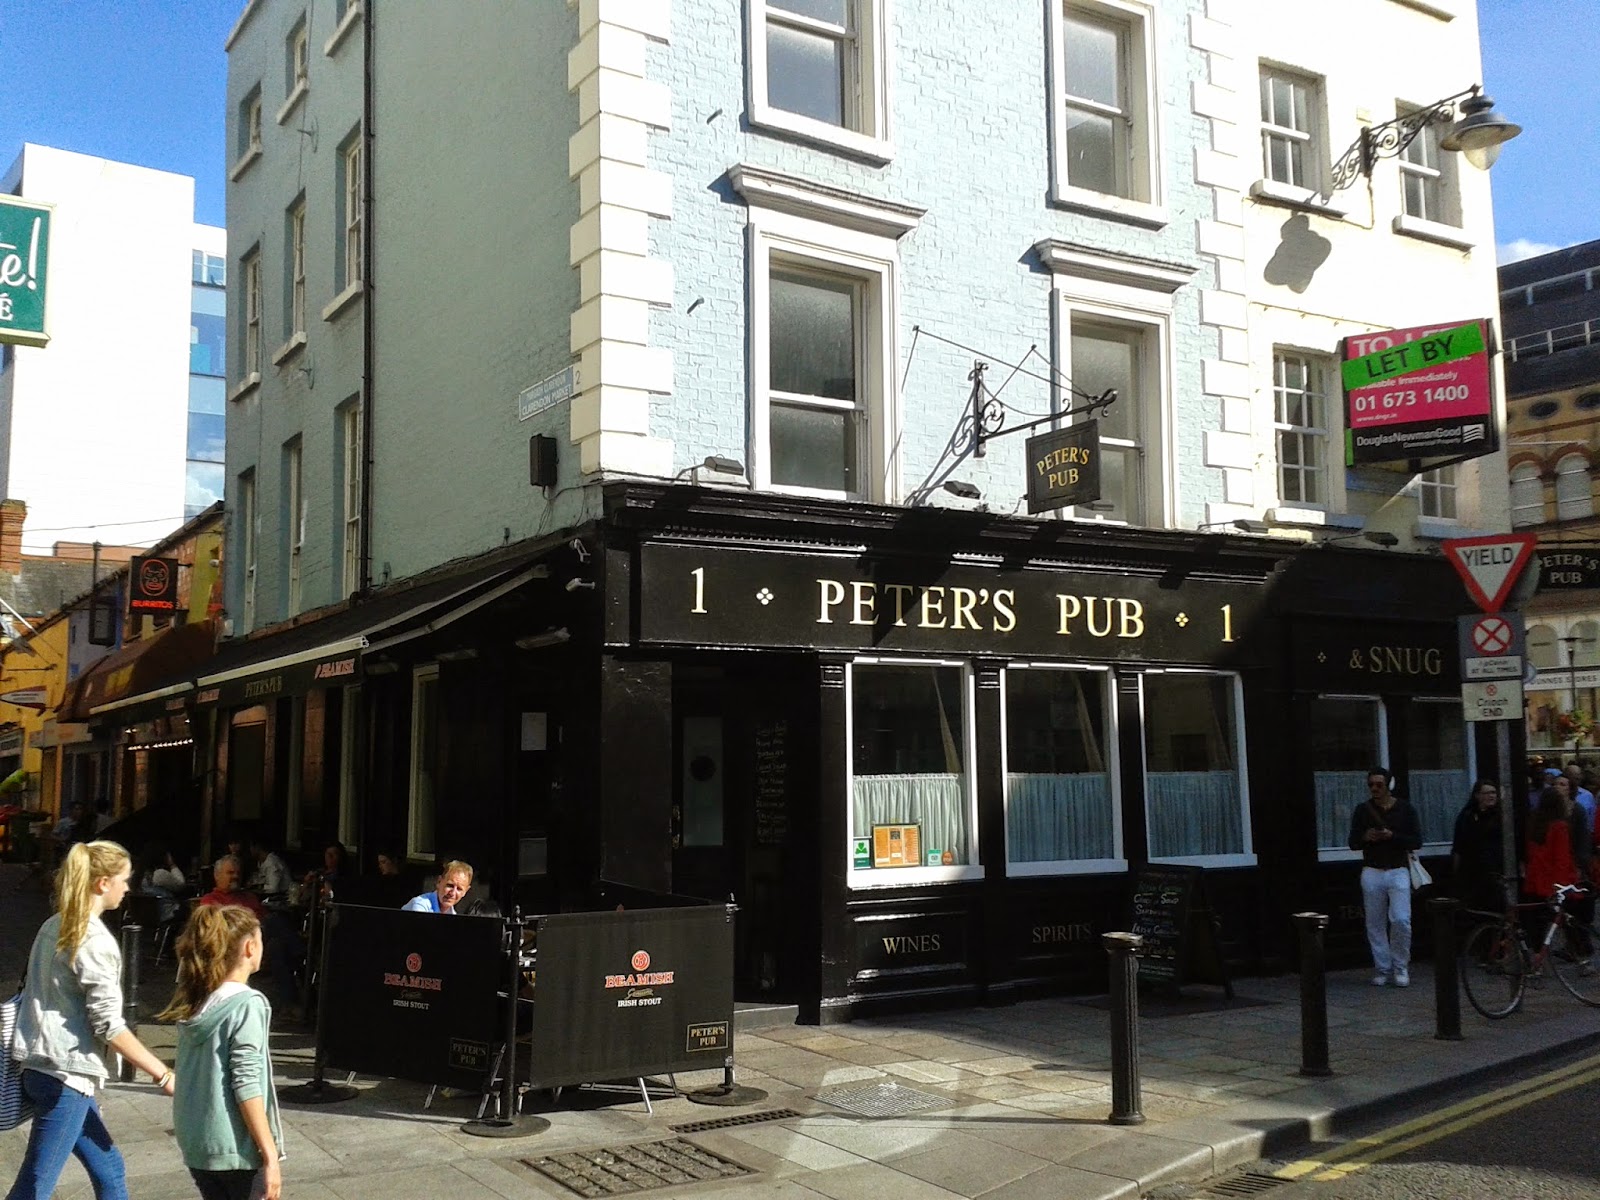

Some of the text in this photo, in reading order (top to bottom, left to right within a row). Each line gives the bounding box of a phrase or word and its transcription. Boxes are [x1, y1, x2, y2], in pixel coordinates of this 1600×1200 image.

[1365, 334, 1454, 378] LET BY
[575, 370, 581, 385] 2
[522, 383, 572, 416] CLARENDON MARKET
[1355, 384, 1469, 412] 01 673 1400
[1356, 426, 1461, 448] DouglasNewmanGood
[1036, 446, 1090, 476] PETER'S
[1048, 467, 1079, 489] PUB
[1462, 546, 1514, 566] YIELD
[1551, 571, 1582, 584] PUB
[690, 566, 1235, 643] 1 PETER'S PUB 1
[1349, 645, 1442, 676] & SNUG
[1566, 674, 1598, 683] SORES
[1483, 707, 1504, 717] END
[1032, 923, 1094, 944] SPIRITS
[881, 934, 941, 955] WINES
[383, 972, 443, 991] BEAMISH
[605, 971, 674, 989] BEAMISH
[392, 999, 430, 1010] IRISH STOUT
[618, 997, 662, 1008] IRISH STOUT
[691, 1025, 726, 1038] PETER'S
[453, 1042, 487, 1056] PETER'S
[699, 1036, 717, 1047] PUB
[460, 1054, 477, 1066] PUB
